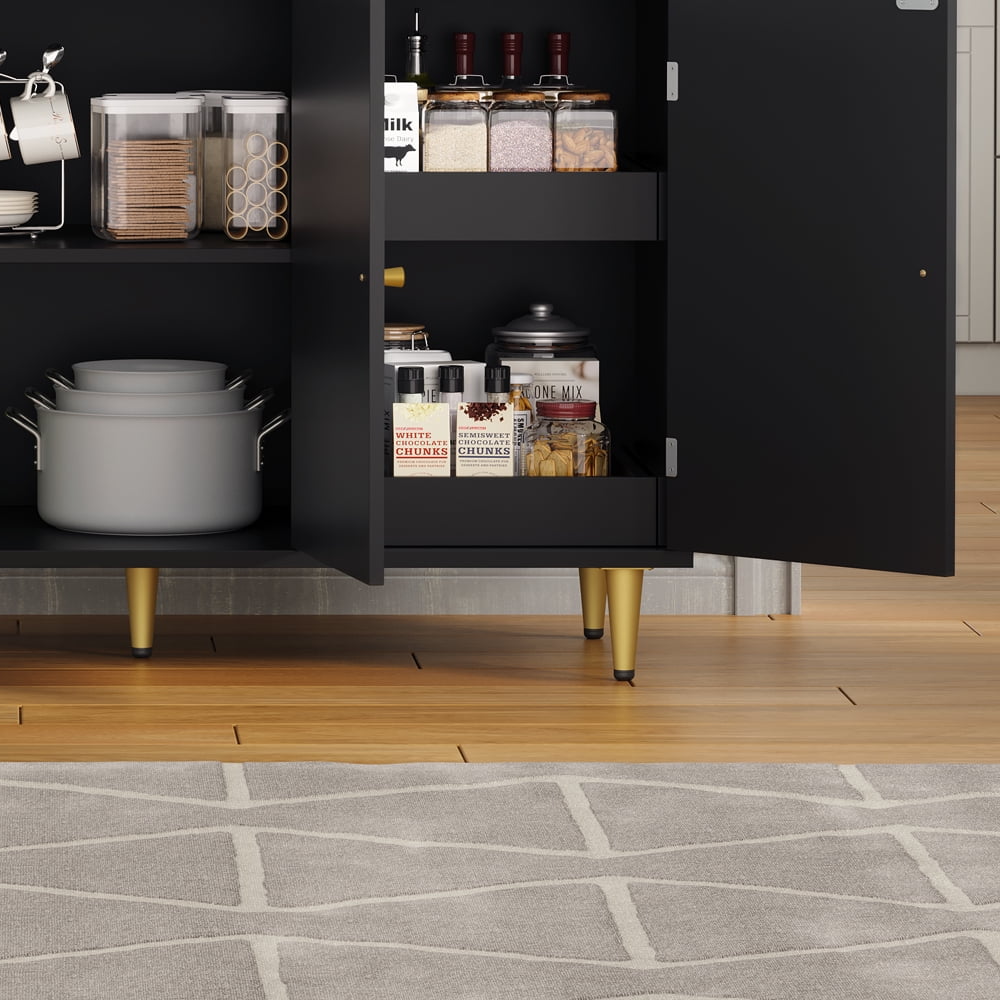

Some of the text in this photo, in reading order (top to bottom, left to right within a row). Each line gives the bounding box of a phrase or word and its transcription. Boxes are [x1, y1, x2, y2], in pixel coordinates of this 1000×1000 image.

[384, 118, 412, 131] ilk
[562, 385, 582, 400] MIX
[396, 447, 448, 455] CHUNKS
[458, 447, 510, 455] CHUNKS
